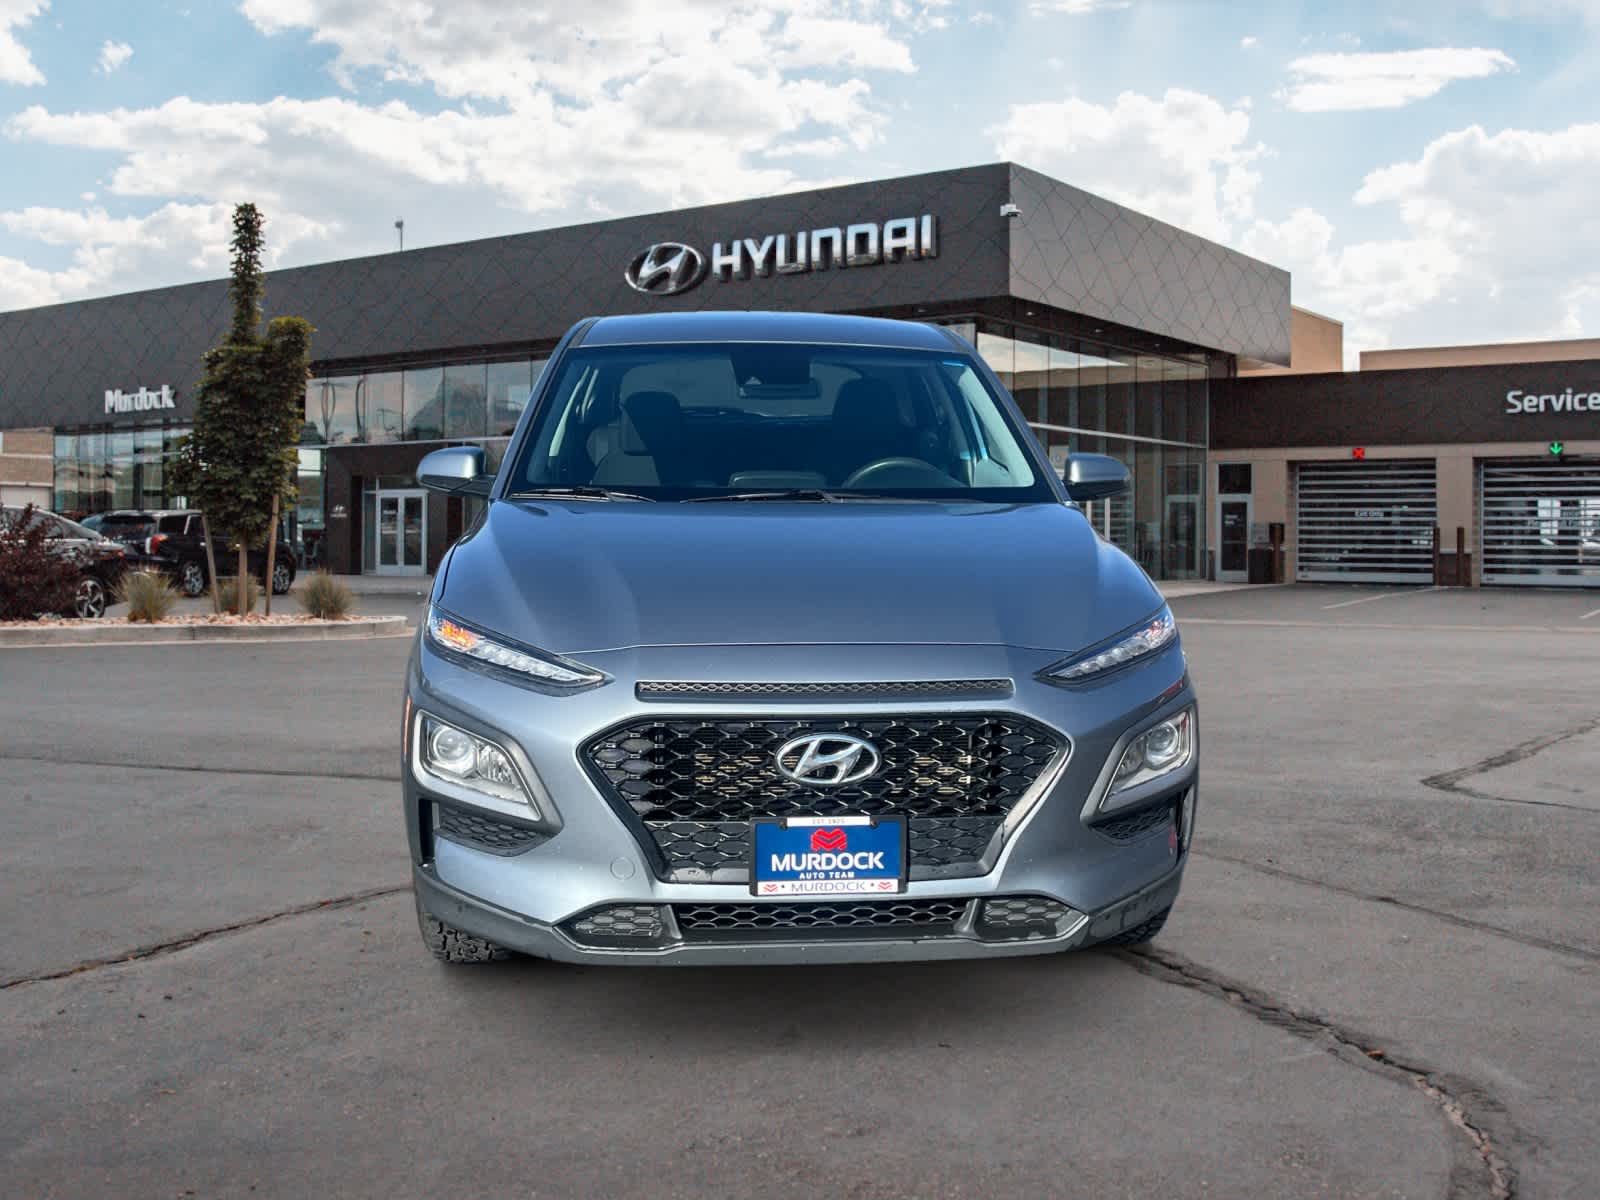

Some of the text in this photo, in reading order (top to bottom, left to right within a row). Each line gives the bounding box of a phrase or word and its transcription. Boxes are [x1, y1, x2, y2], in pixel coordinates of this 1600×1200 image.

[712, 214, 936, 282] HYUNDAI
[104, 384, 176, 414] Murdock
[1505, 387, 1600, 413] Service
[771, 852, 885, 872] MURDOCK
[791, 881, 866, 892] MURDOCK
[829, 871, 855, 879] TEAM
